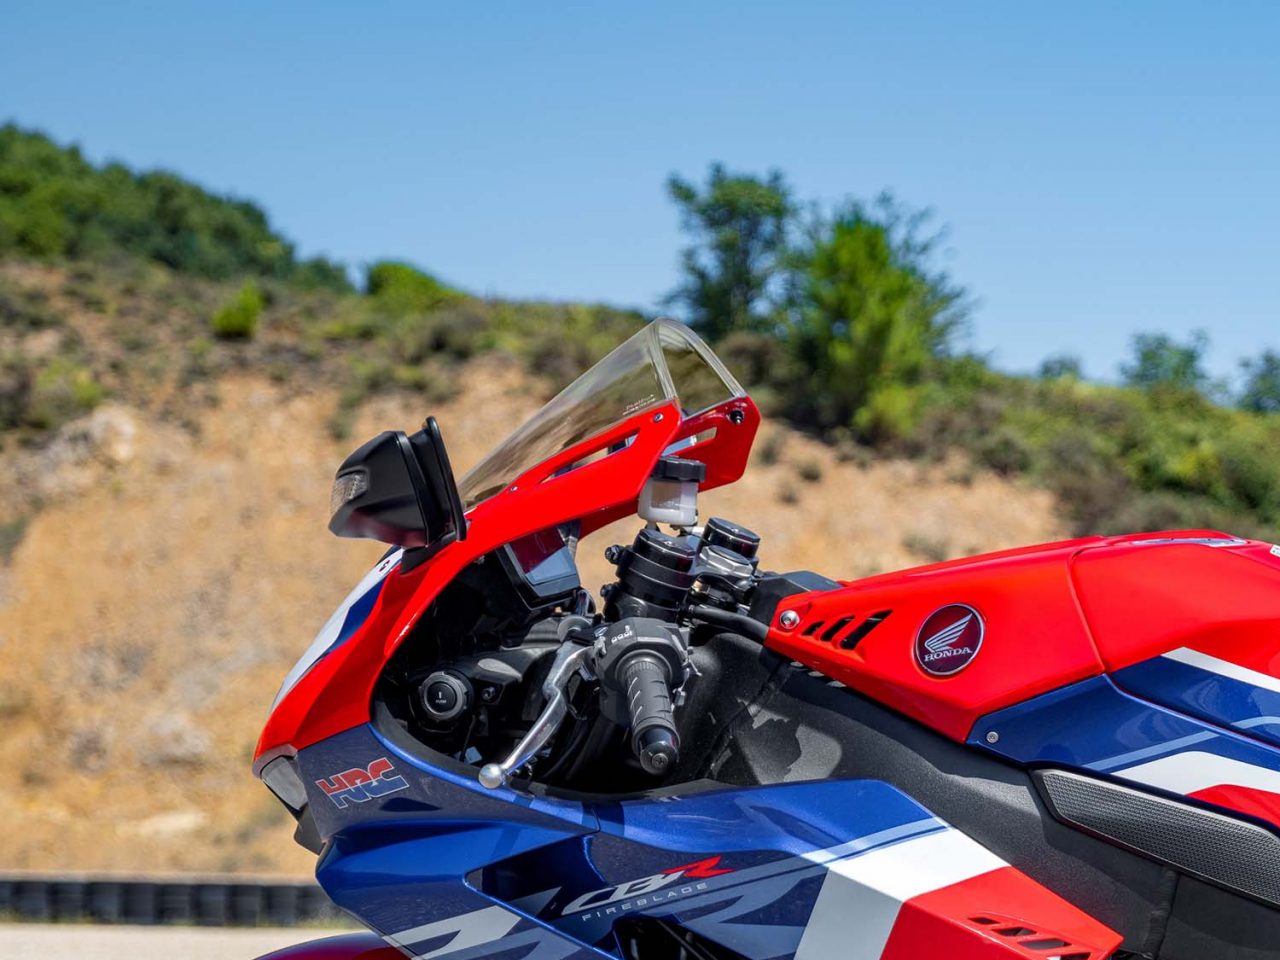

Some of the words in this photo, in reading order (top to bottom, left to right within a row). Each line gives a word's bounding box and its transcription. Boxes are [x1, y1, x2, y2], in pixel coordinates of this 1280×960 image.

[924, 646, 973, 662] HONDA
[315, 757, 410, 809] HRC
[561, 855, 736, 916] CBR
[581, 882, 708, 922] FIREBLADE
